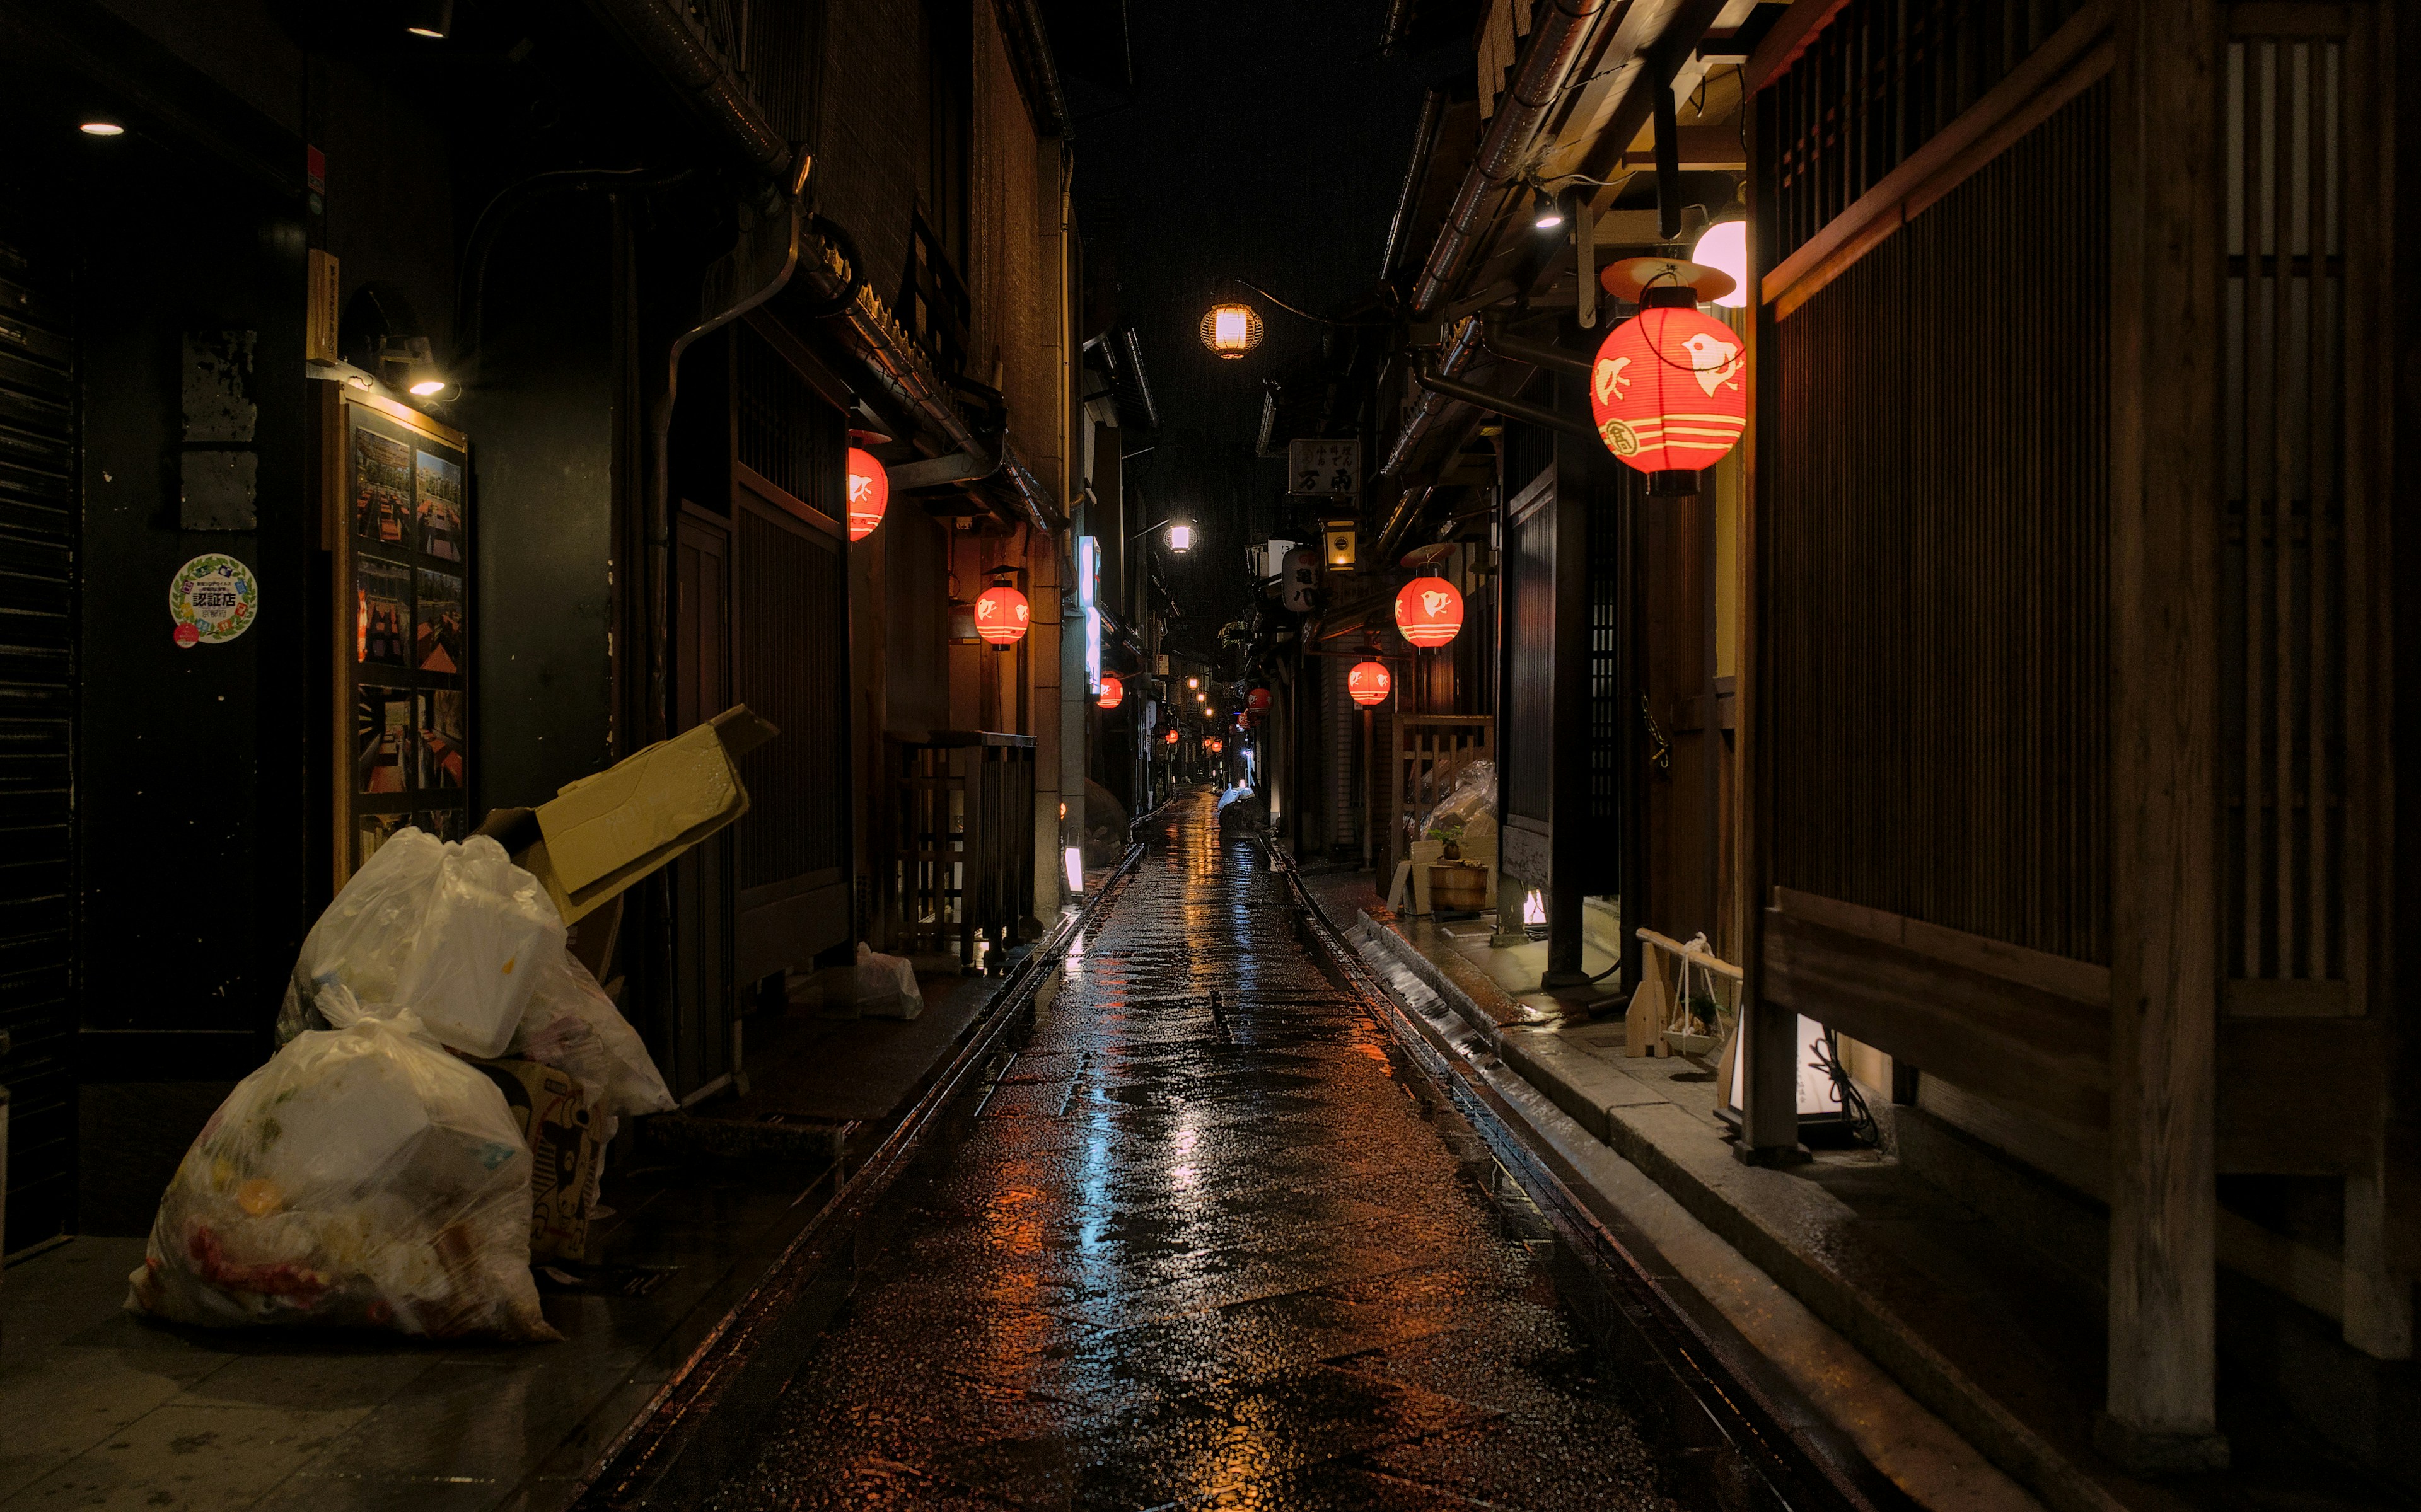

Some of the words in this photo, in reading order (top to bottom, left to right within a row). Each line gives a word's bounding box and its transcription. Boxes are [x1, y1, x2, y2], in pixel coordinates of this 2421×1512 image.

[1316, 445, 1352, 456] 小料理
[1317, 456, 1352, 466] おでん
[192, 593, 236, 606] 認証店
[202, 609, 226, 618] 京都府
